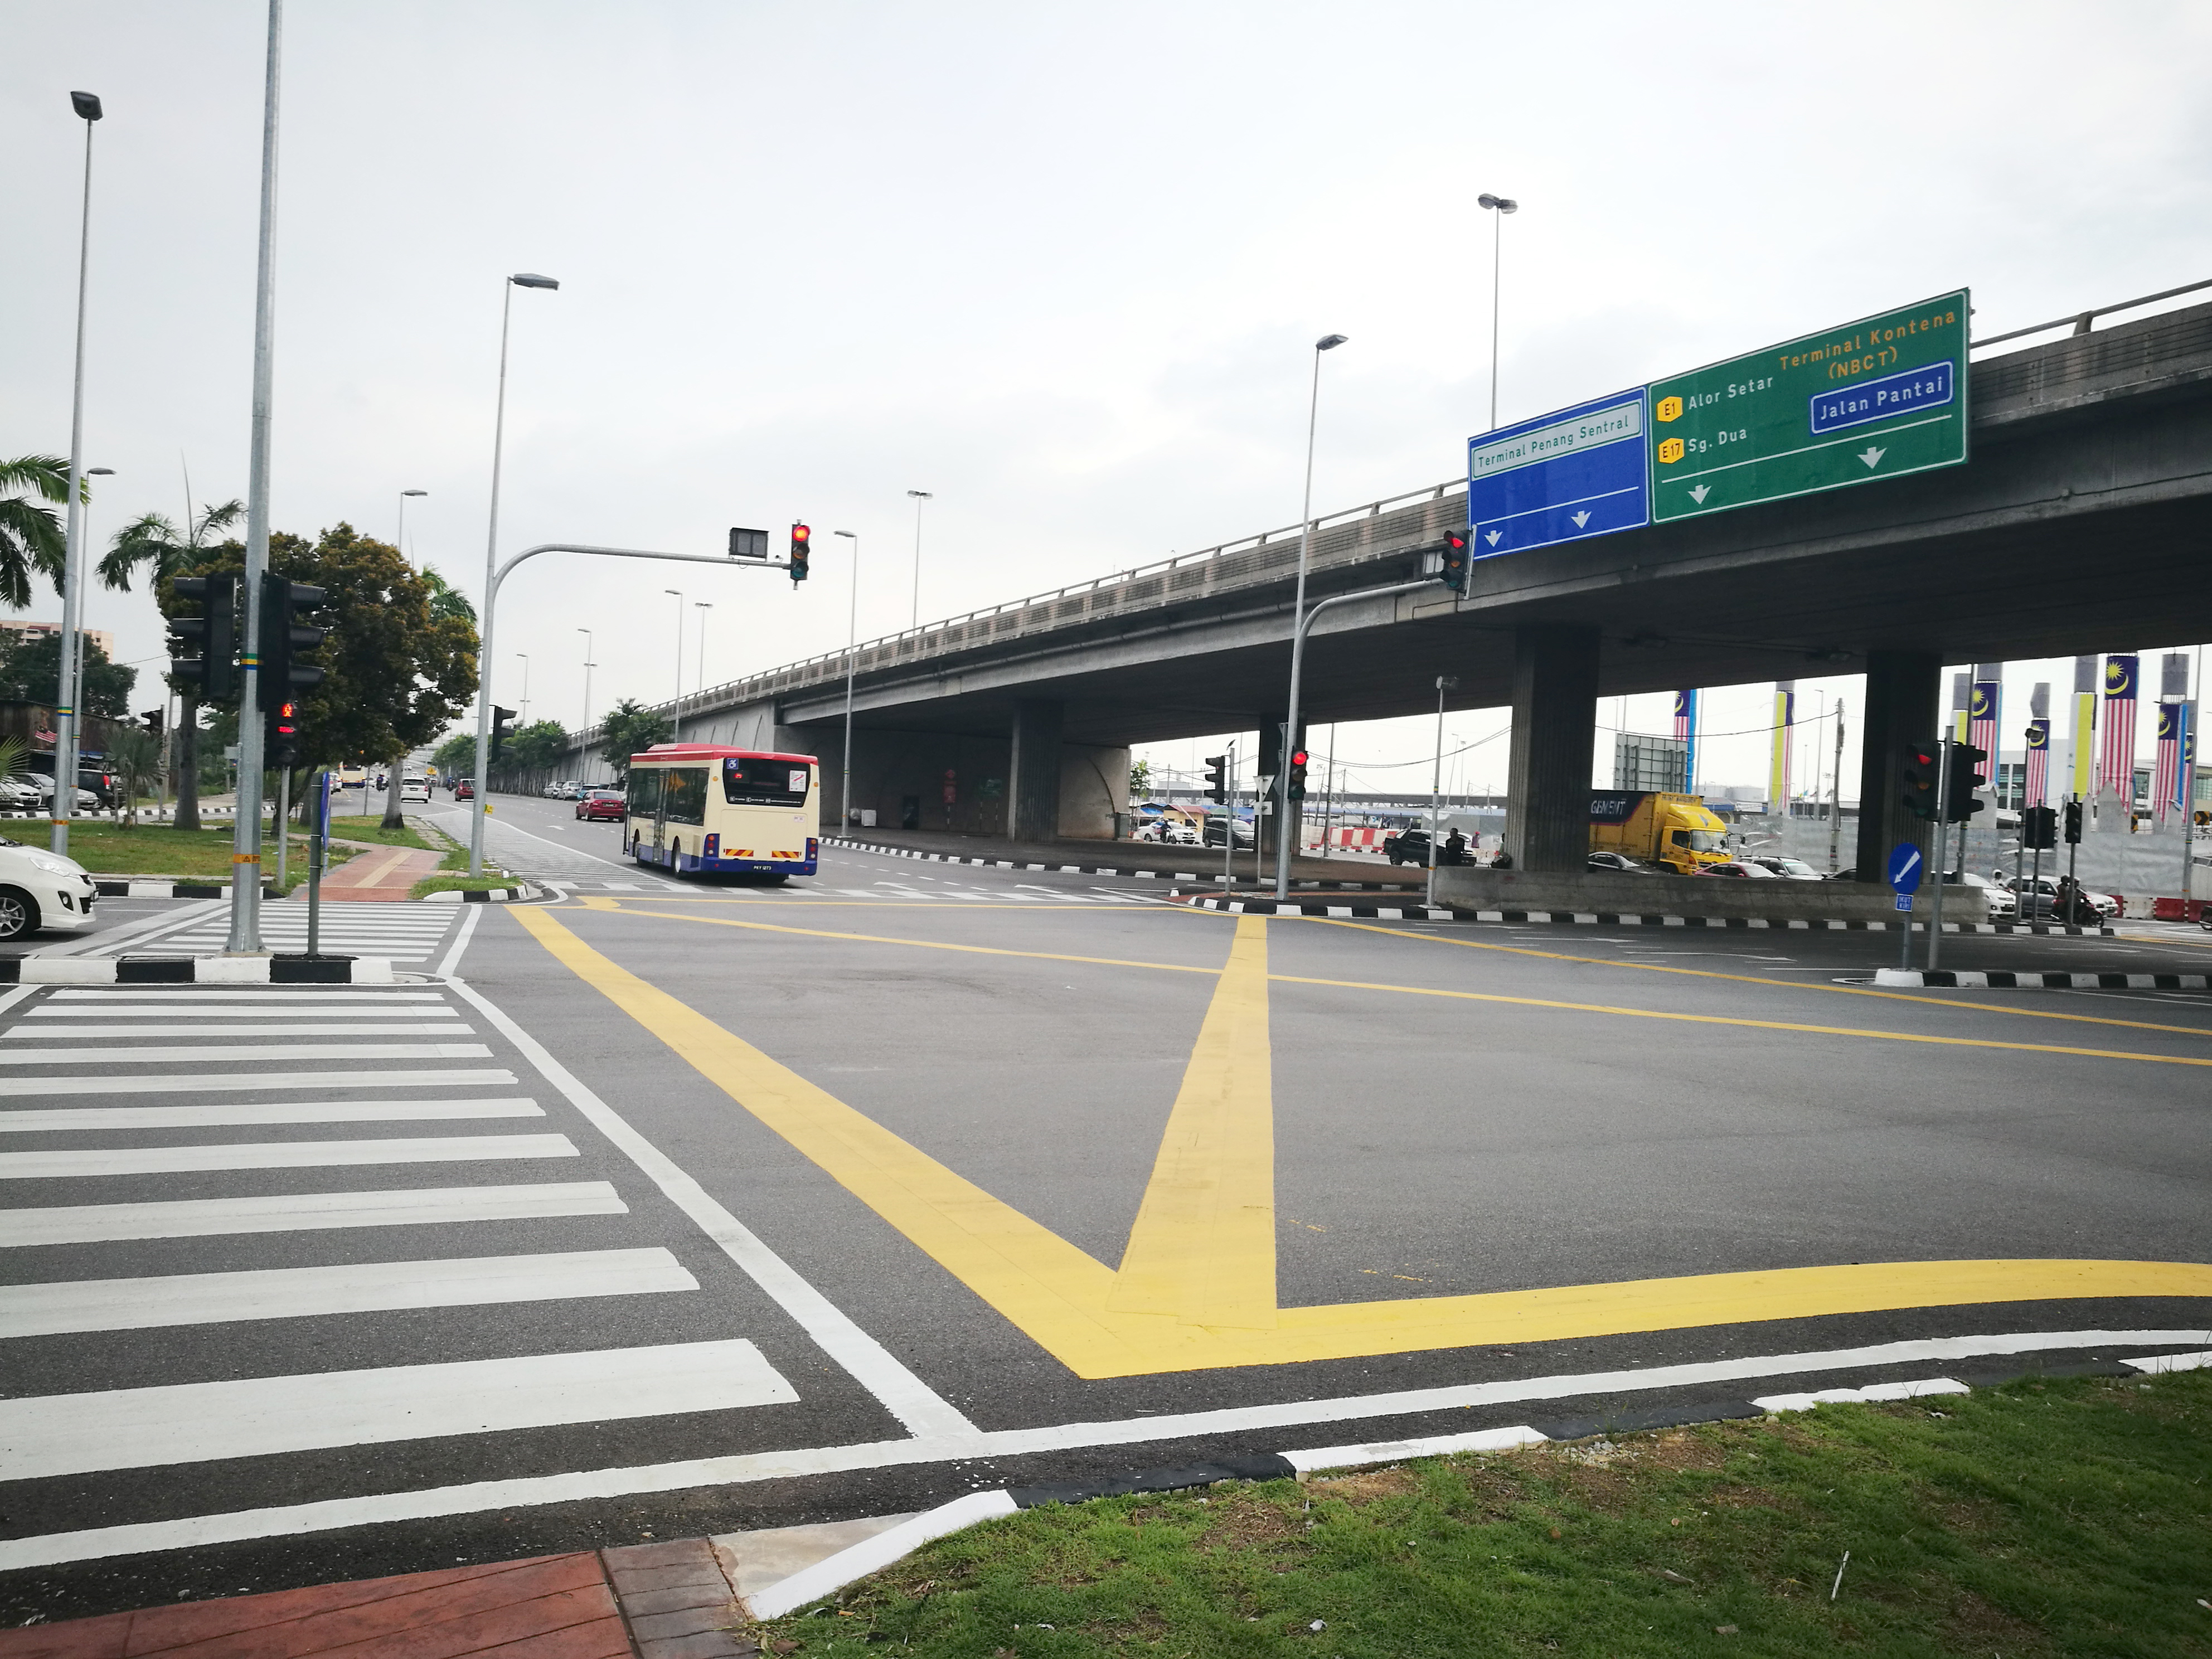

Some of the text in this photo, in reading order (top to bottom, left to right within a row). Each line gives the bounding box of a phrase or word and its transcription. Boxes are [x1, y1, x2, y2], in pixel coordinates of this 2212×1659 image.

[1779, 311, 1955, 371] Terminal Kontena
[1827, 346, 1898, 379] (NBCT)
[1664, 402, 1675, 416] E1
[1689, 377, 1773, 410] Alor Setar
[1821, 376, 1942, 420] Jalan Pantai
[1478, 415, 1628, 468] Terminal Penang Sentral
[1689, 429, 1747, 453] Sg. Dua
